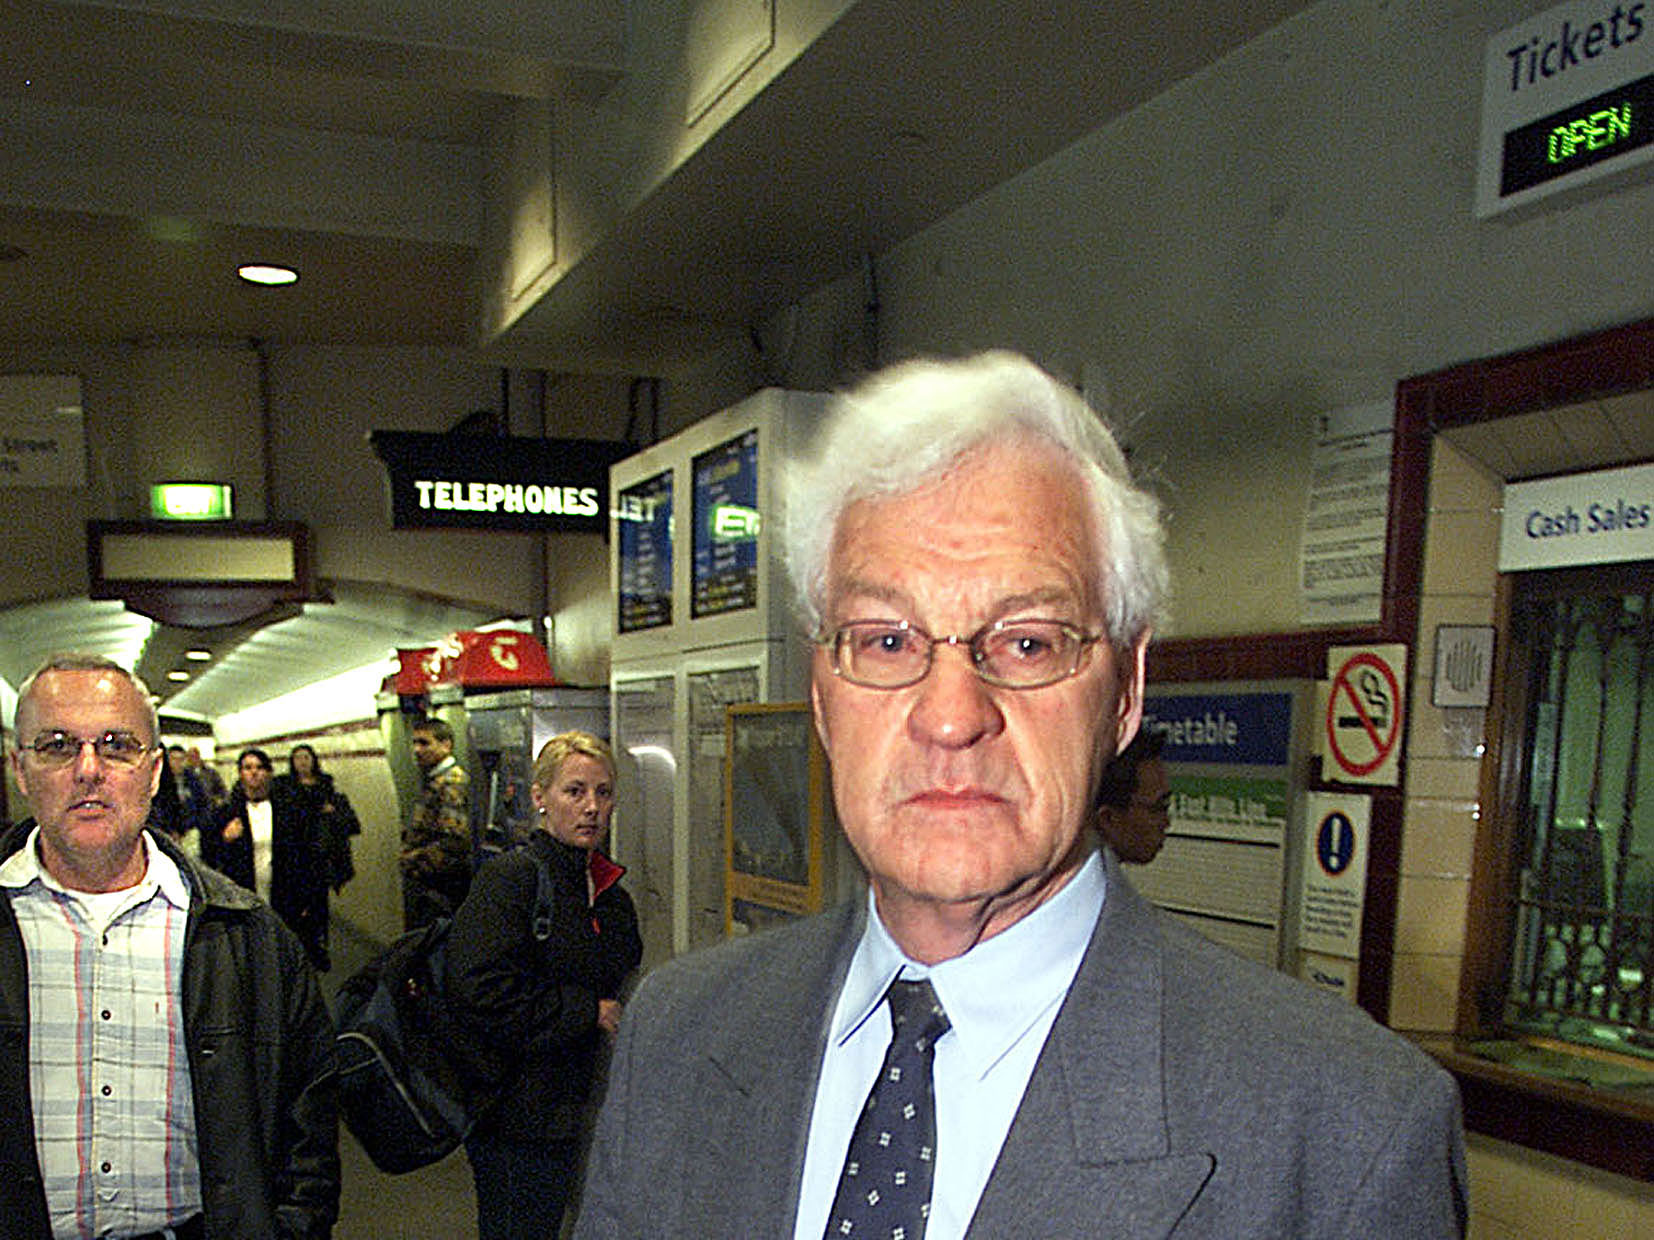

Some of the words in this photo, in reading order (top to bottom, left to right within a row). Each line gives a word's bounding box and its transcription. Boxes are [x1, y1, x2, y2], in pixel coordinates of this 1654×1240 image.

[1505, 2, 1646, 91] Tickets
[1547, 101, 1633, 163] OPEN
[413, 480, 600, 517] TELEPHONES
[1526, 505, 1579, 538] Cash
[1587, 498, 1651, 533] Sales
